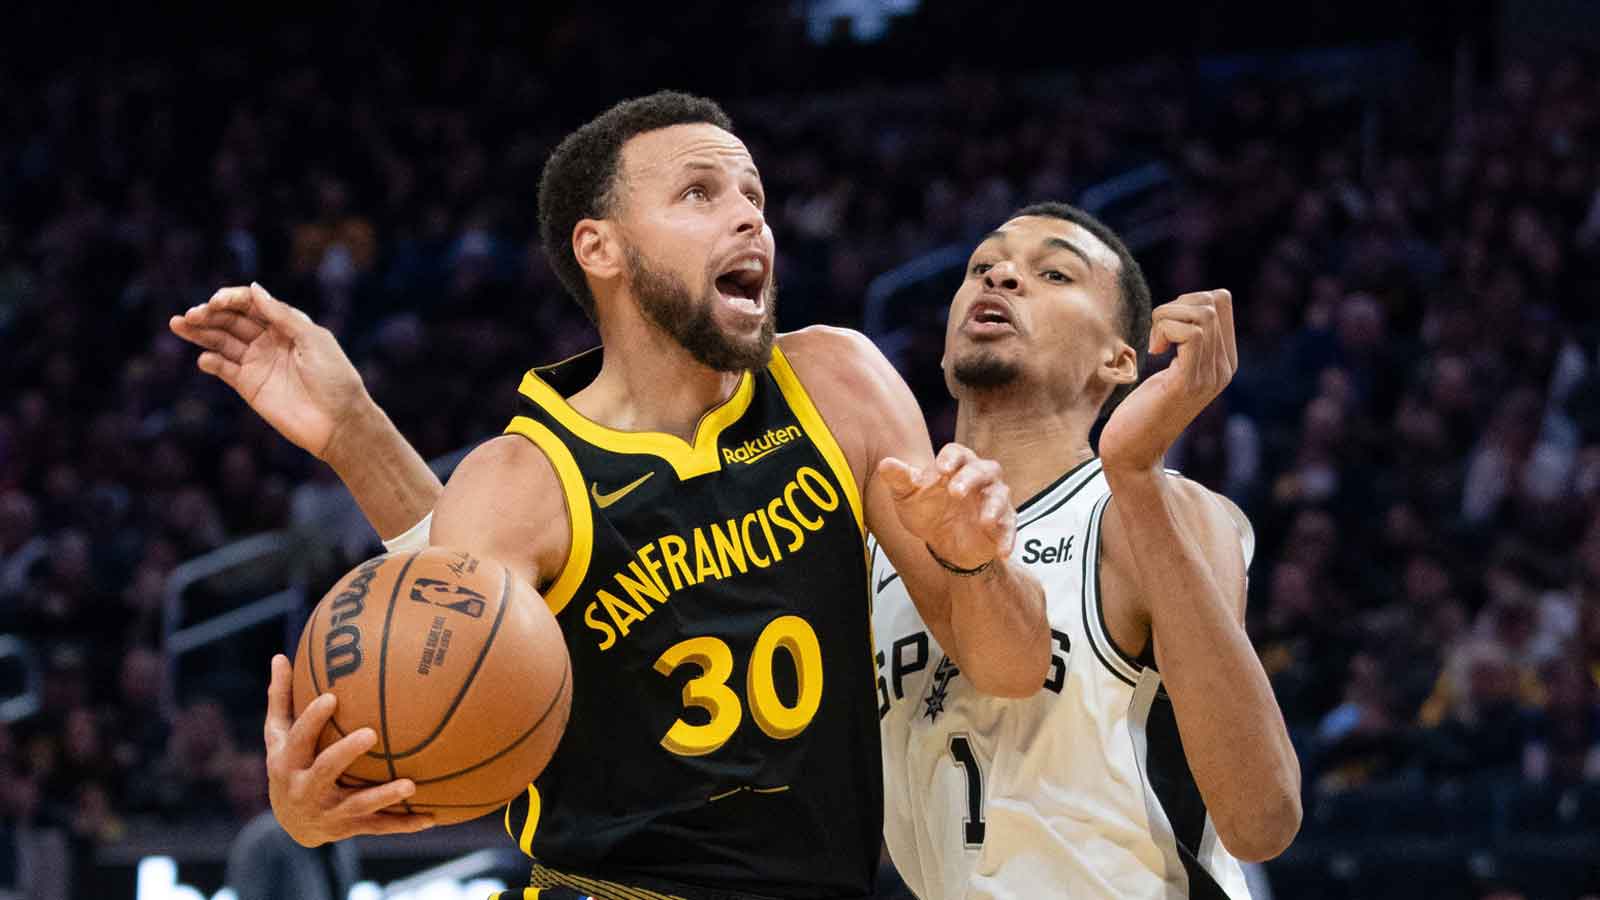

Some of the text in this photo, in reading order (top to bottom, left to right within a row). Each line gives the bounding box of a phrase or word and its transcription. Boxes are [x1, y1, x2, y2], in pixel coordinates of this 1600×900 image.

[721, 424, 802, 465] Rakuten
[652, 615, 824, 757] 30
[950, 732, 987, 849] 1
